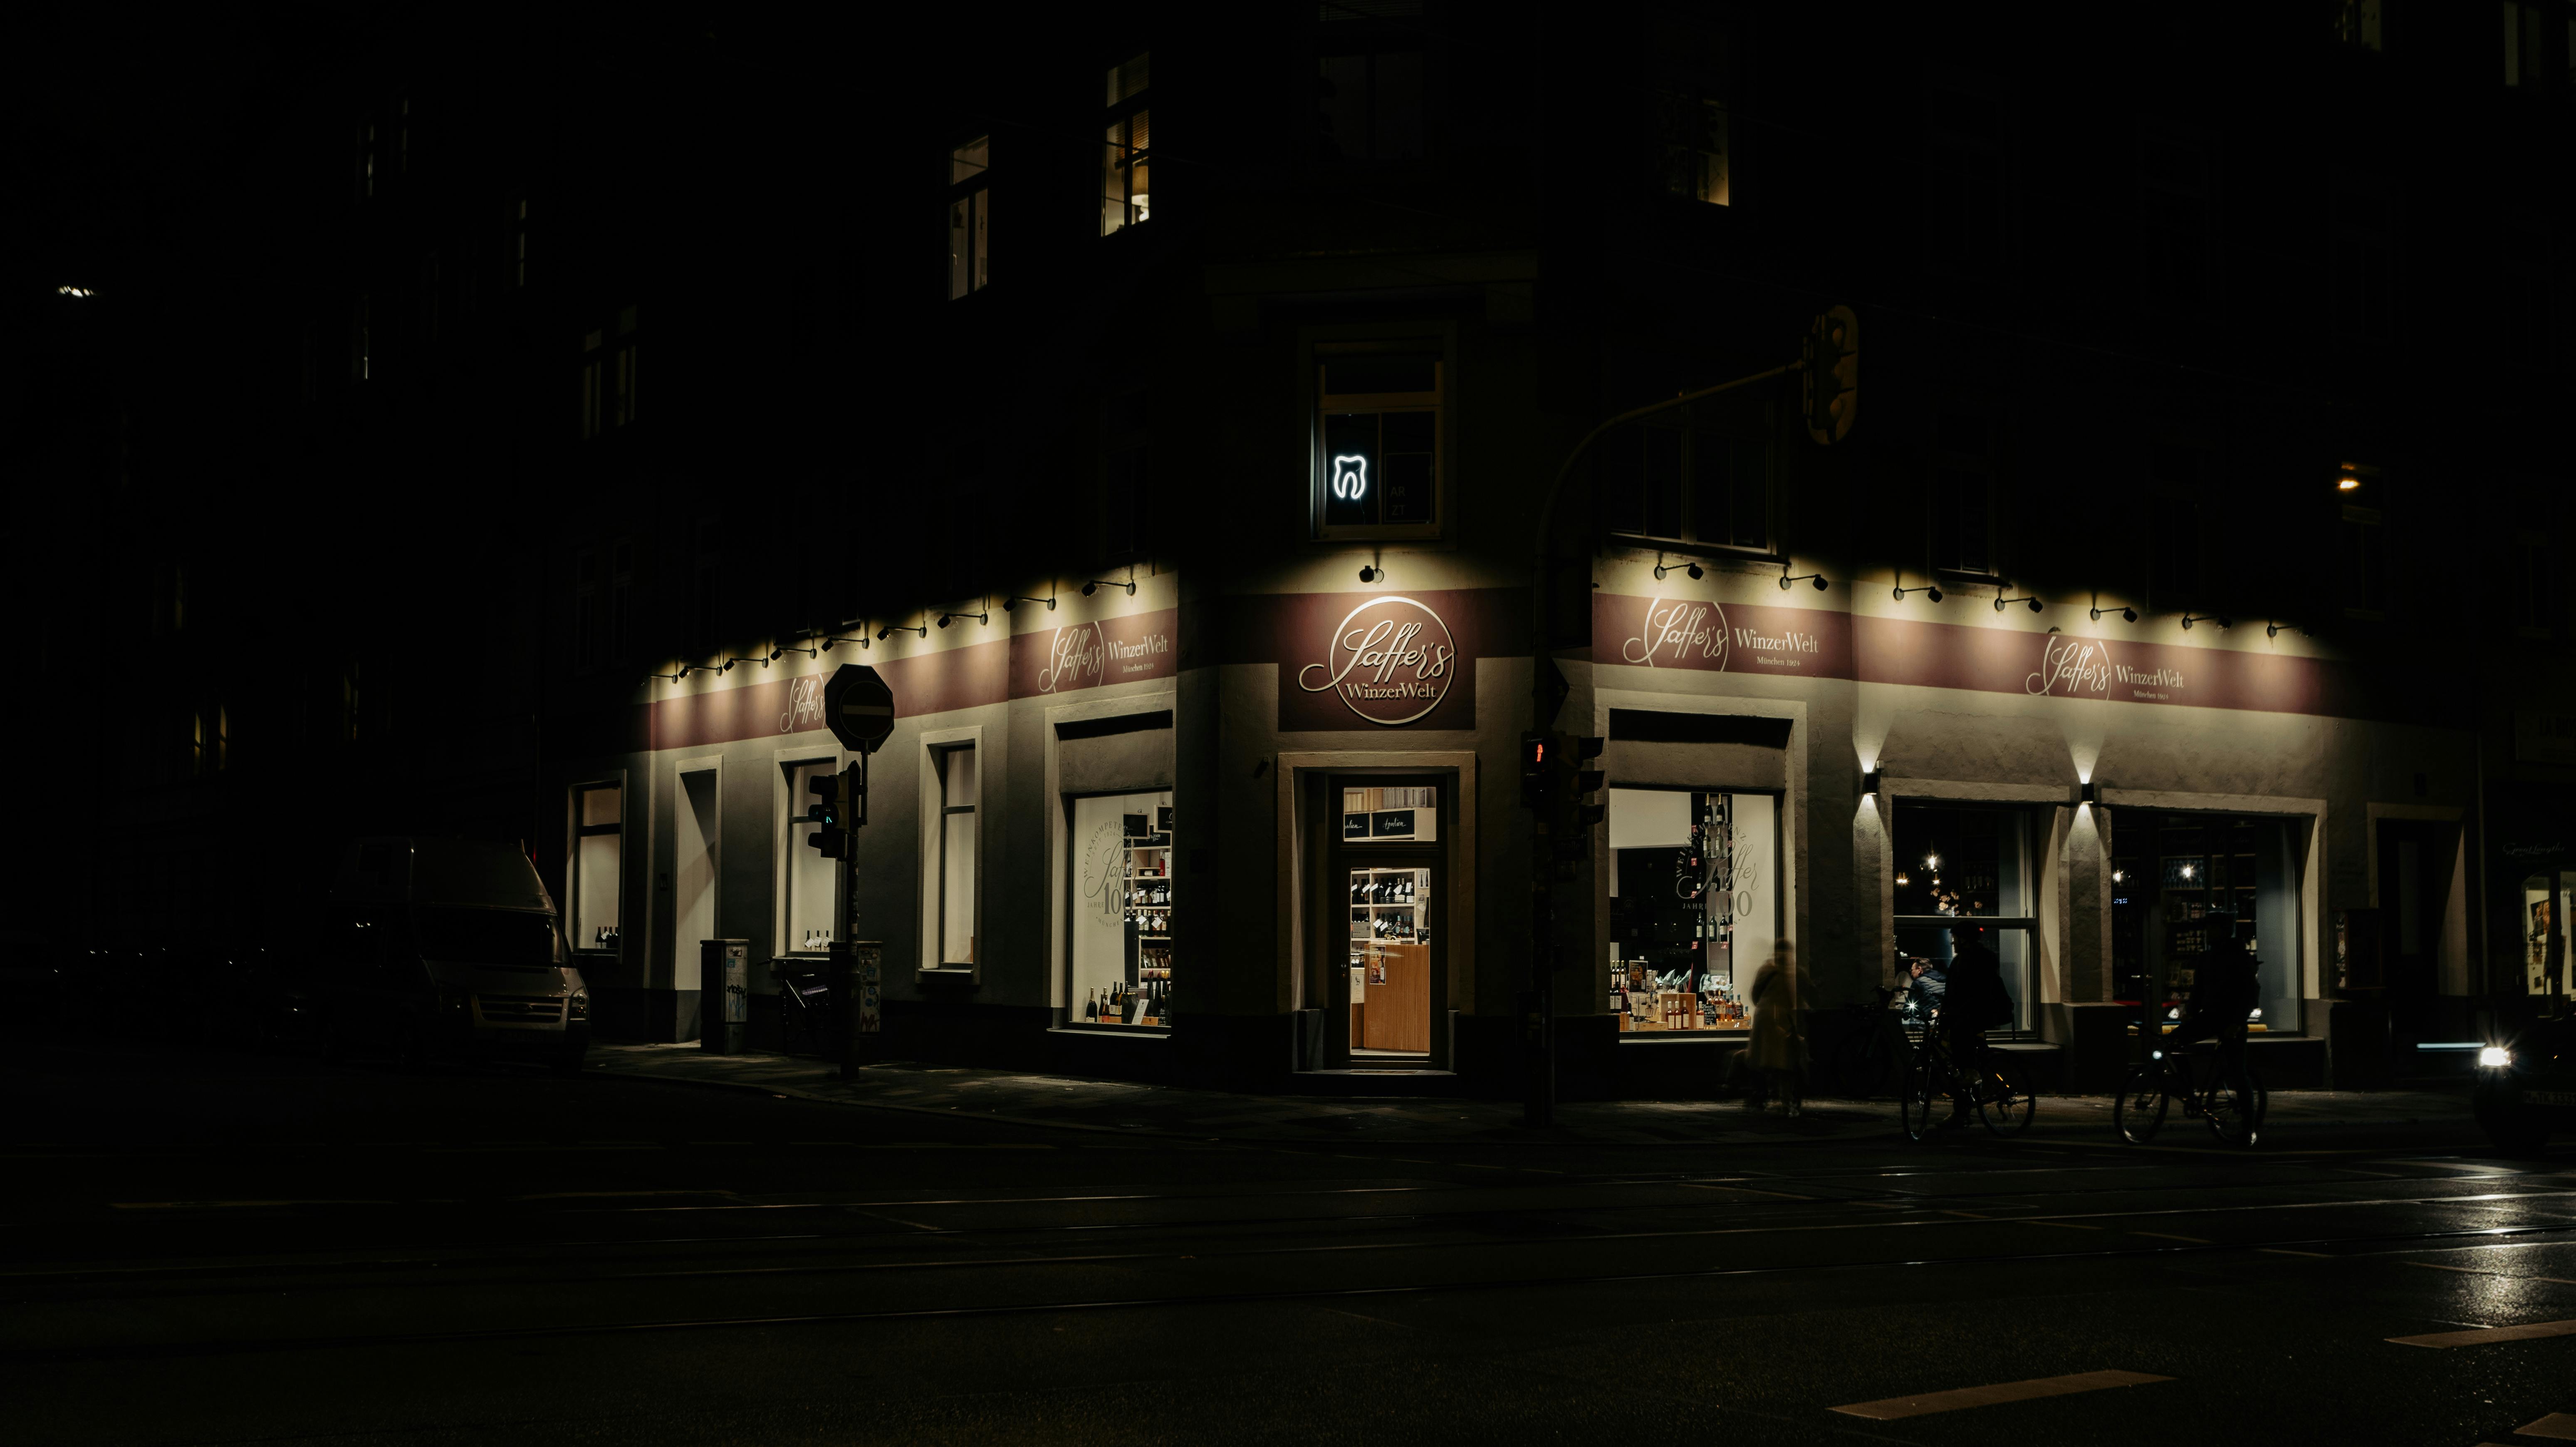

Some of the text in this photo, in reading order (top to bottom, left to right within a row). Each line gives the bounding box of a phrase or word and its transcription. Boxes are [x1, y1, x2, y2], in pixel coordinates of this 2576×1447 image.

[1108, 634, 1168, 661] WinzerWelt
[1735, 628, 1819, 653] WinzerWelt
[1123, 662, 1154, 674] München 1924
[1757, 656, 1801, 667] München 1924
[2116, 664, 2185, 689] WinzerWelt
[1346, 682, 1436, 699] WinzerWelt
[2133, 690, 2156, 699] München
